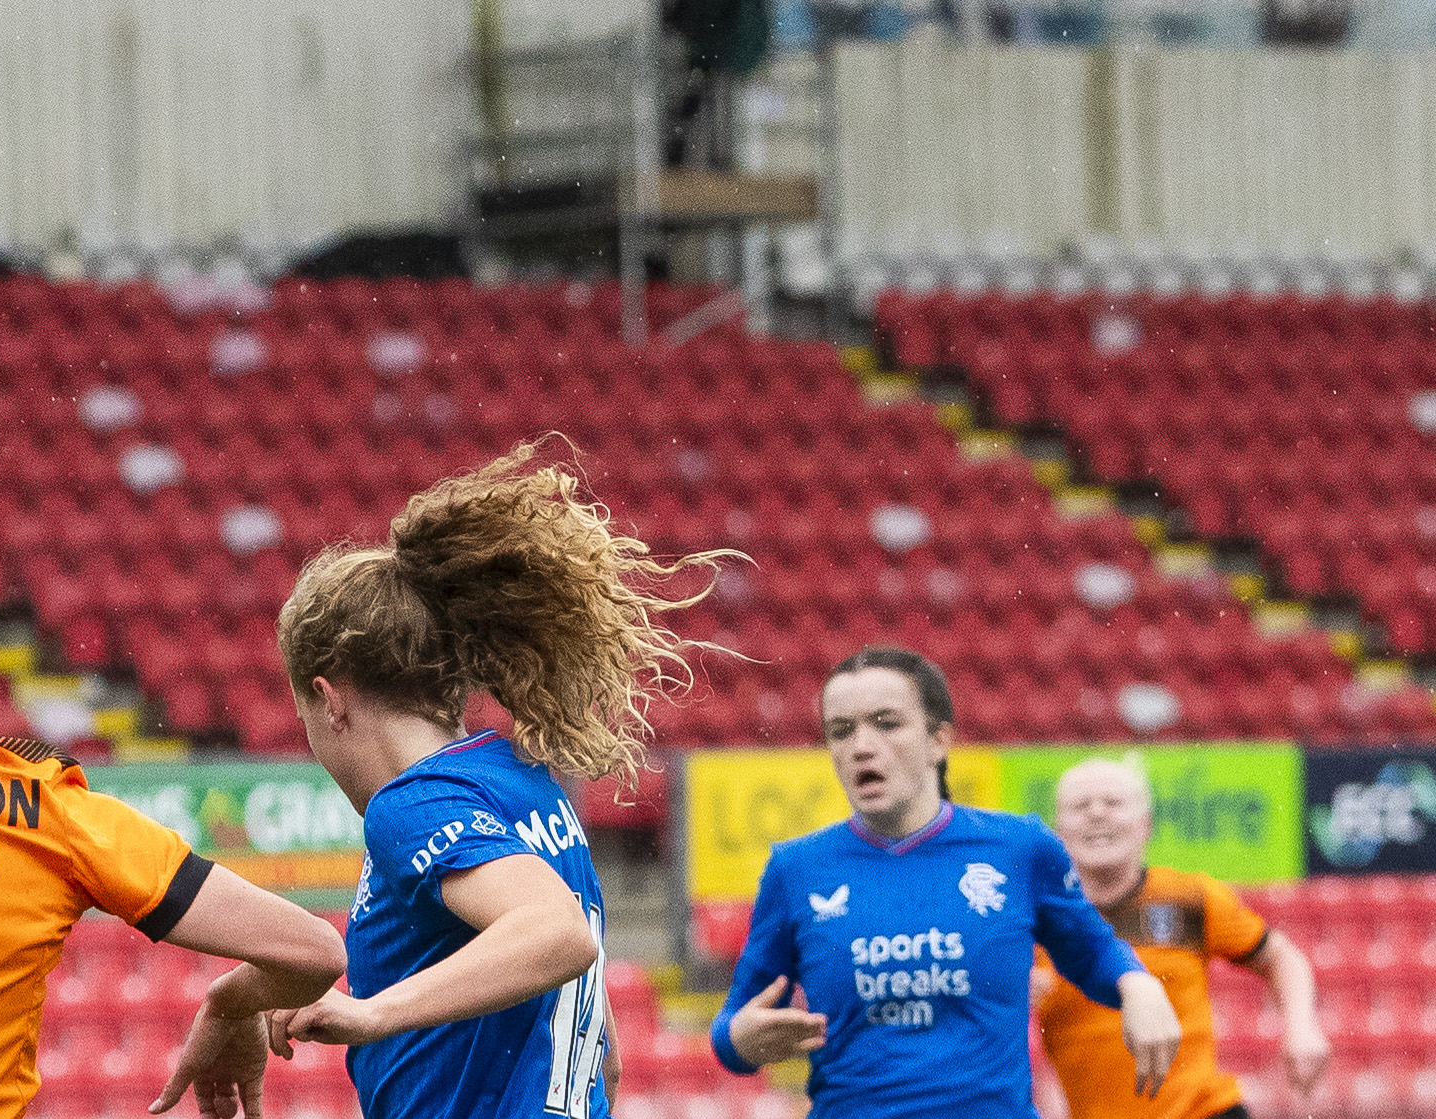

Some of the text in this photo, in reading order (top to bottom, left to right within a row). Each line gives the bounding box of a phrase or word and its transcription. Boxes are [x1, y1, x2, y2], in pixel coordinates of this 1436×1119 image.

[411, 820, 465, 875] DCP
[515, 798, 589, 857] McA
[851, 927, 965, 967] sports
[854, 962, 971, 1000] breaks
[866, 1000, 934, 1027] com
